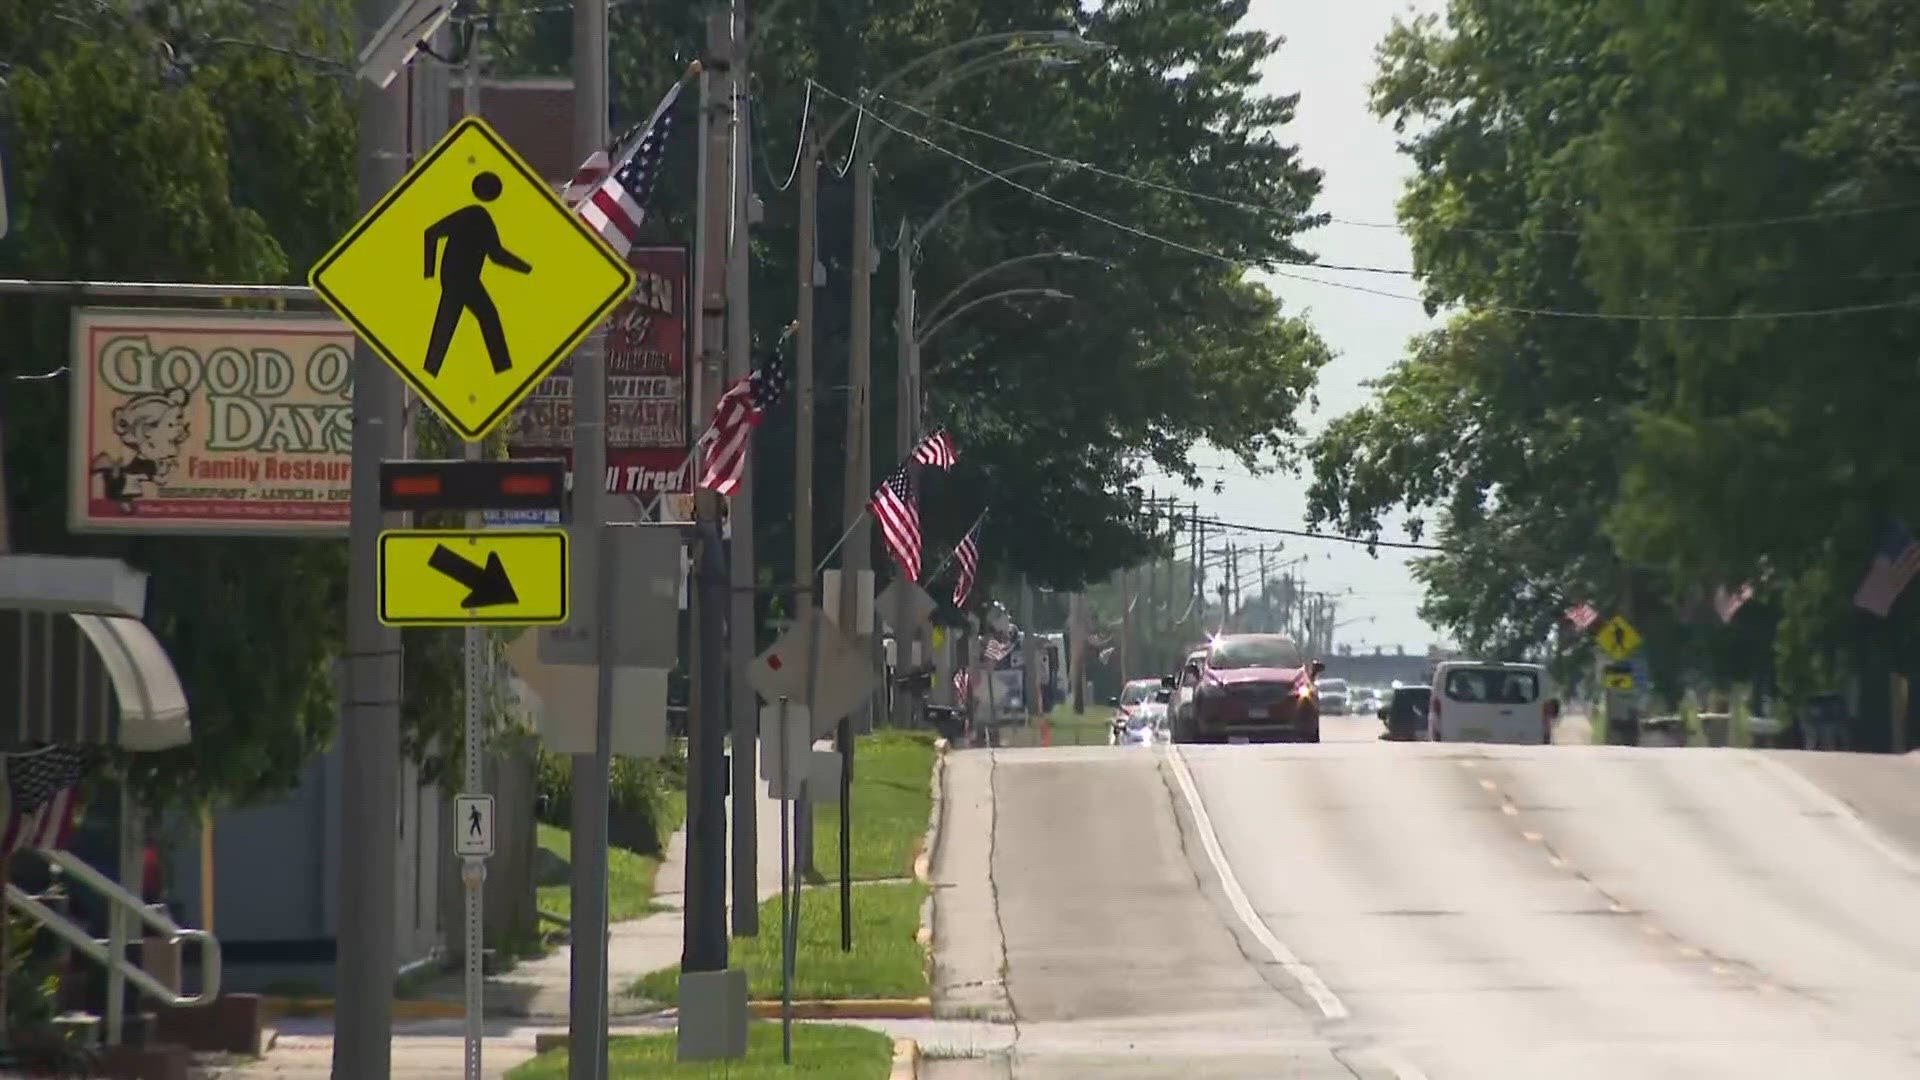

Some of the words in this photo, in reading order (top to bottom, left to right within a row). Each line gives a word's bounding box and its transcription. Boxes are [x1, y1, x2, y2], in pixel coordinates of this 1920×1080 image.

[100, 335, 294, 398] GOOD
[306, 343, 354, 400] O
[608, 377, 667, 397] WING
[206, 393, 353, 454] DAYS
[188, 456, 259, 482] Family
[265, 456, 351, 481] Restaur
[626, 465, 687, 492] Tires!
